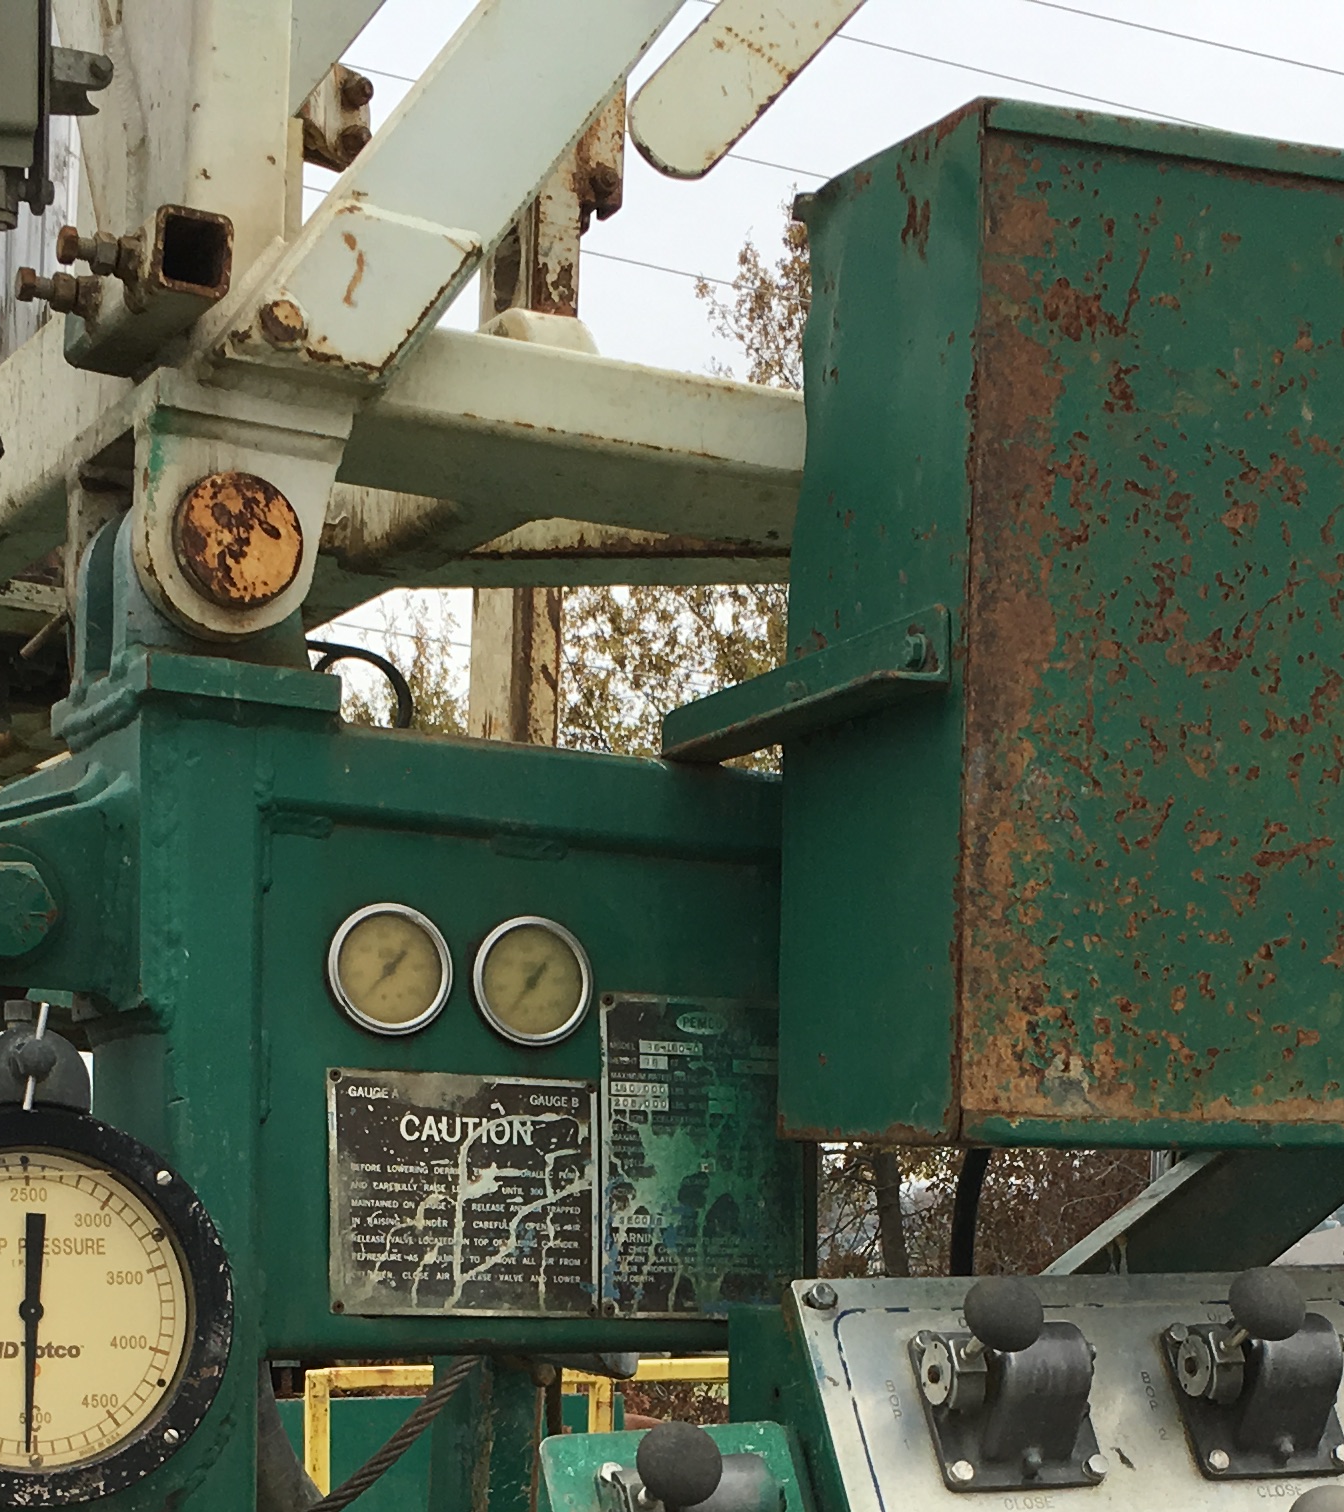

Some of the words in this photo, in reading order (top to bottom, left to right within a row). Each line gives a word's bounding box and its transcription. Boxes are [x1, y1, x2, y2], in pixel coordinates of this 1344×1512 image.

[348, 1086, 389, 1099] GAUGE
[530, 1094, 568, 1107] GAUGE
[572, 1097, 580, 1108] B
[399, 1113, 534, 1146] CAUTION
[10, 1187, 47, 1202] 2500
[502, 1186, 524, 1195] UNTIL
[351, 1199, 399, 1208] MAINTAINED
[471, 1203, 505, 1212] RELEASE
[547, 1205, 581, 1215] TRAPPED
[74, 1213, 112, 1227] 3000
[474, 1238, 489, 1246] TOP
[613, 1232, 654, 1243] WARNIN
[18, 1237, 106, 1255] PESSURE
[522, 1257, 536, 1265] ALL
[559, 1258, 581, 1266] FROM
[106, 1270, 143, 1286] 3500
[436, 1271, 450, 1280] AIR
[499, 1273, 523, 1282] VALVE
[553, 1275, 581, 1283] LOWER
[20, 1341, 81, 1358] otco
[110, 1335, 147, 1350] 4000
[81, 1394, 119, 1409] 4500
[1141, 1371, 1157, 1412] BOP
[1159, 1427, 1170, 1441] 2
[19, 1412, 52, 1424] 500
[1257, 1484, 1302, 1498] CLOSE
[1004, 1495, 1056, 1511] CLOSE
